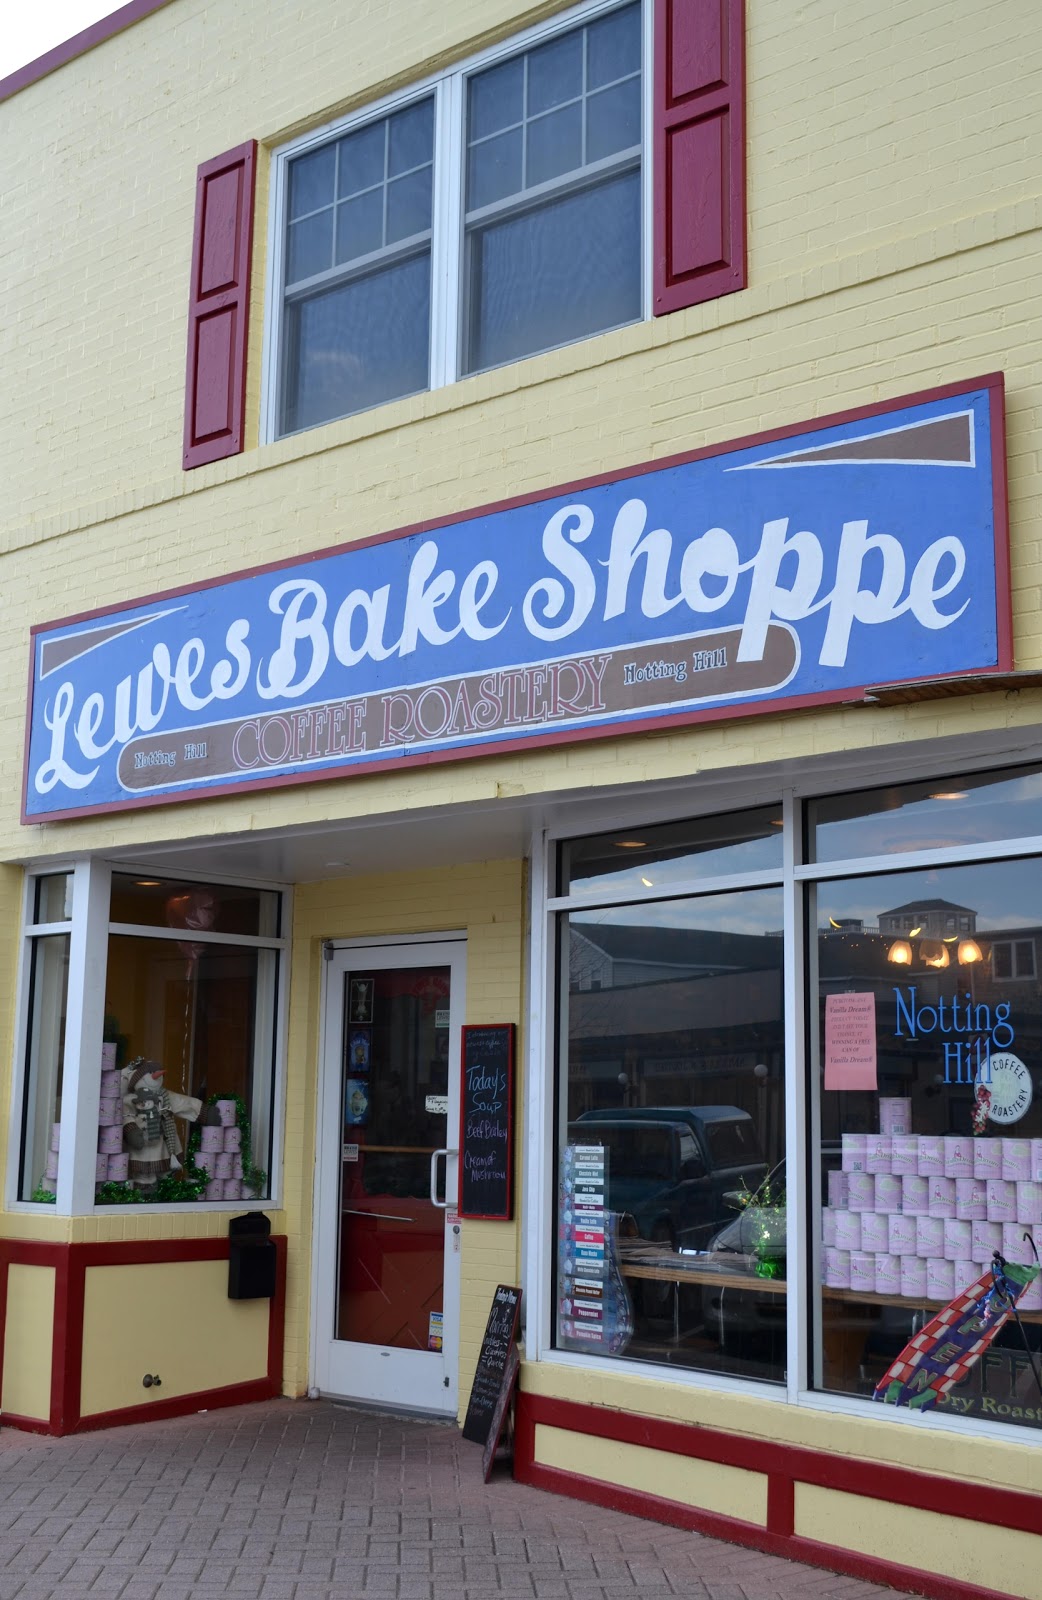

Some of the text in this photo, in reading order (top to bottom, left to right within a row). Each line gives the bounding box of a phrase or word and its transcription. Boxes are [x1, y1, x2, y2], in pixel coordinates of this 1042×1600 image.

[35, 499, 971, 794] Lewes Bake Shoppe
[624, 647, 727, 686] Notting Hill
[232, 654, 612, 769] COFFEE ROASTERY
[134, 741, 208, 768] Notting Hill
[893, 987, 1014, 1047] Notting
[943, 1037, 993, 1083] Hill
[993, 1059, 1026, 1080] COFFEE
[992, 1089, 1028, 1117] ROASTERY
